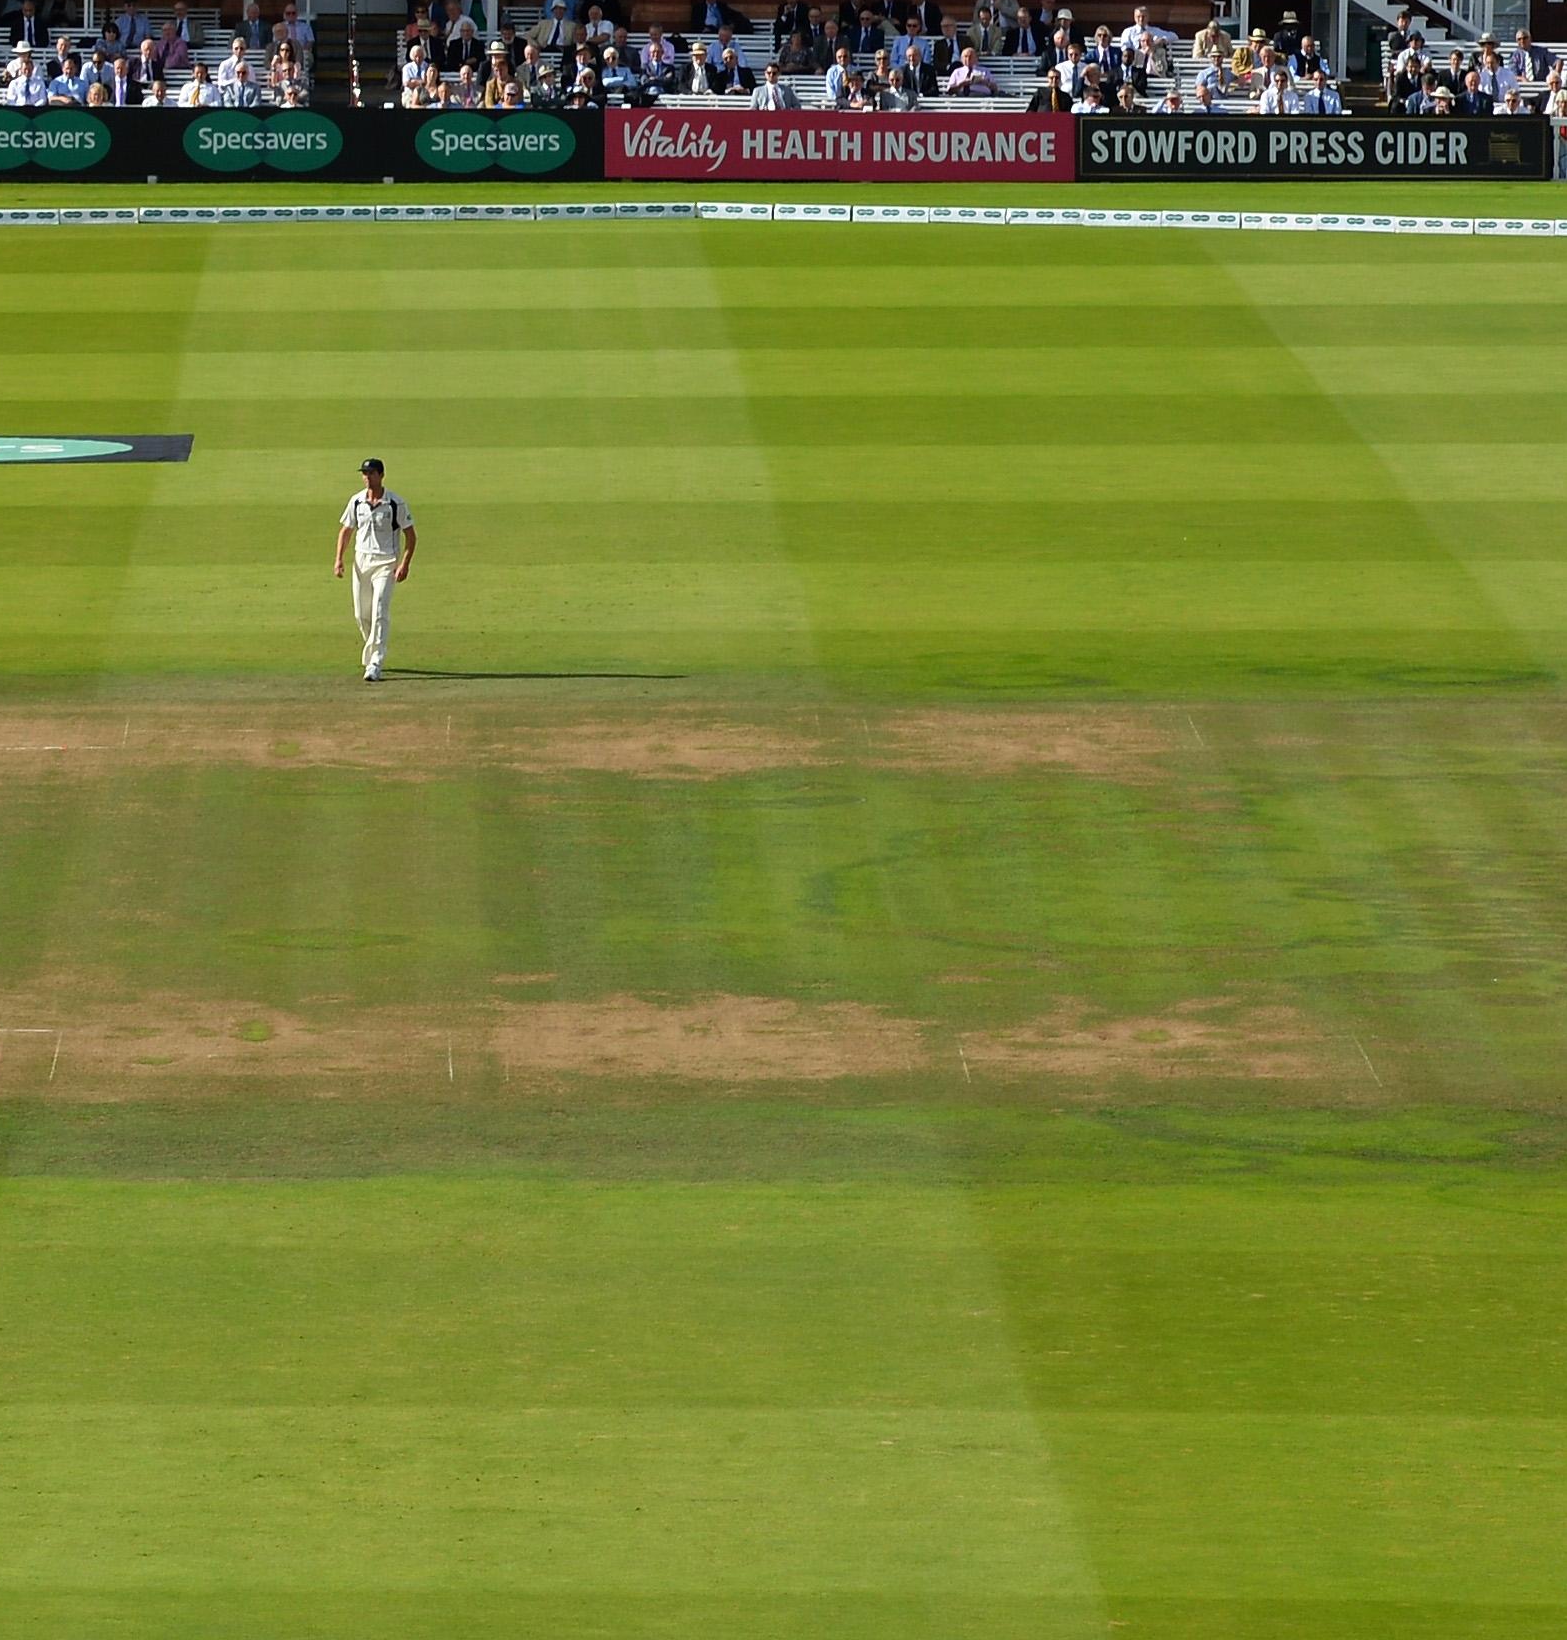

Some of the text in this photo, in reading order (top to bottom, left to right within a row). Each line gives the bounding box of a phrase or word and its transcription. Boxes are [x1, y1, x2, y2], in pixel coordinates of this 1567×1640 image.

[198, 127, 327, 154] Specsavers
[430, 129, 560, 156] Specsavers
[624, 114, 1056, 172] Vitality HEALTH INSURANCE
[1091, 130, 1468, 165] STOWFORD PRESS CIDER
